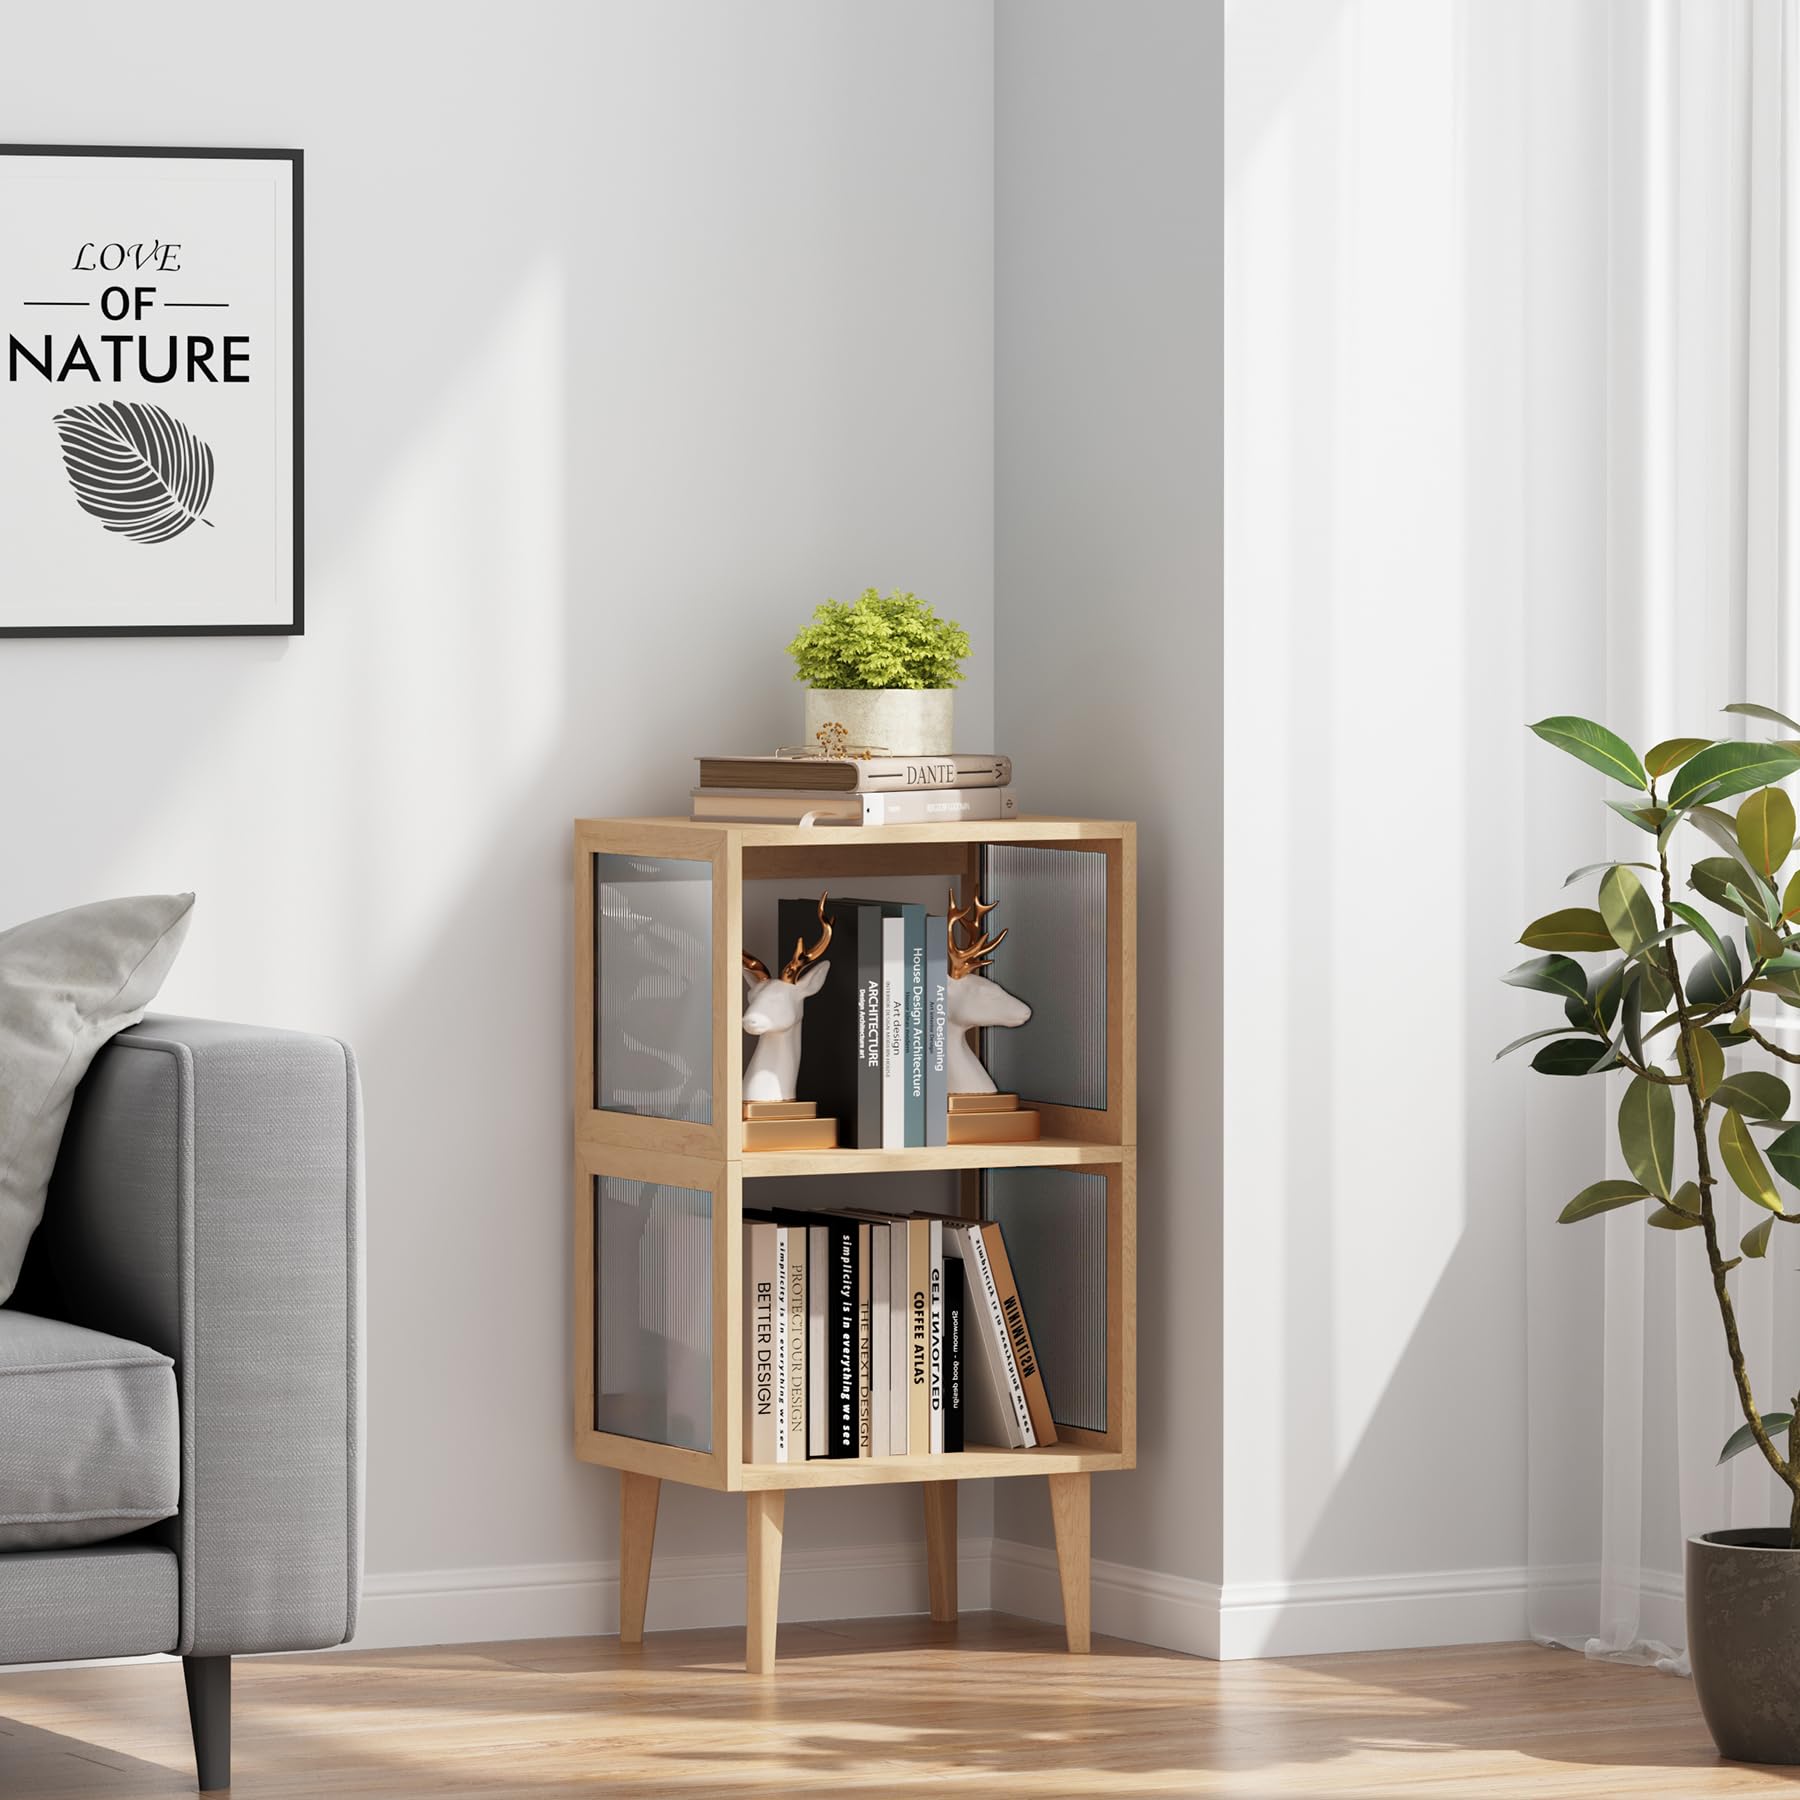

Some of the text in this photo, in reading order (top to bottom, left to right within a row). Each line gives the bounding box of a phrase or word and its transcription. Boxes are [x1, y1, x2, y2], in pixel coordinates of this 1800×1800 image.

[72, 239, 182, 272] LOVE
[101, 286, 157, 320] OF
[10, 334, 250, 383] NATURE
[907, 764, 954, 785] DANTE
[869, 981, 878, 1067] ARCHITECTURE
[892, 1001, 901, 1055] Art design
[911, 948, 923, 1097] House Design Architecture
[935, 985, 945, 1071] Art of Designing
[780, 1308, 785, 1317] is
[780, 1323, 785, 1334] in
[841, 1235, 852, 1446] simplicity is in everything we see
[914, 1292, 925, 1384] COFFEE ATLAS
[758, 1283, 771, 1415] BETTER DESIGN
[791, 1265, 803, 1432] PROTECT OUR DESIGN
[860, 1299, 869, 1448] THE NEXT DESIGN
[780, 1409, 784, 1424] we
